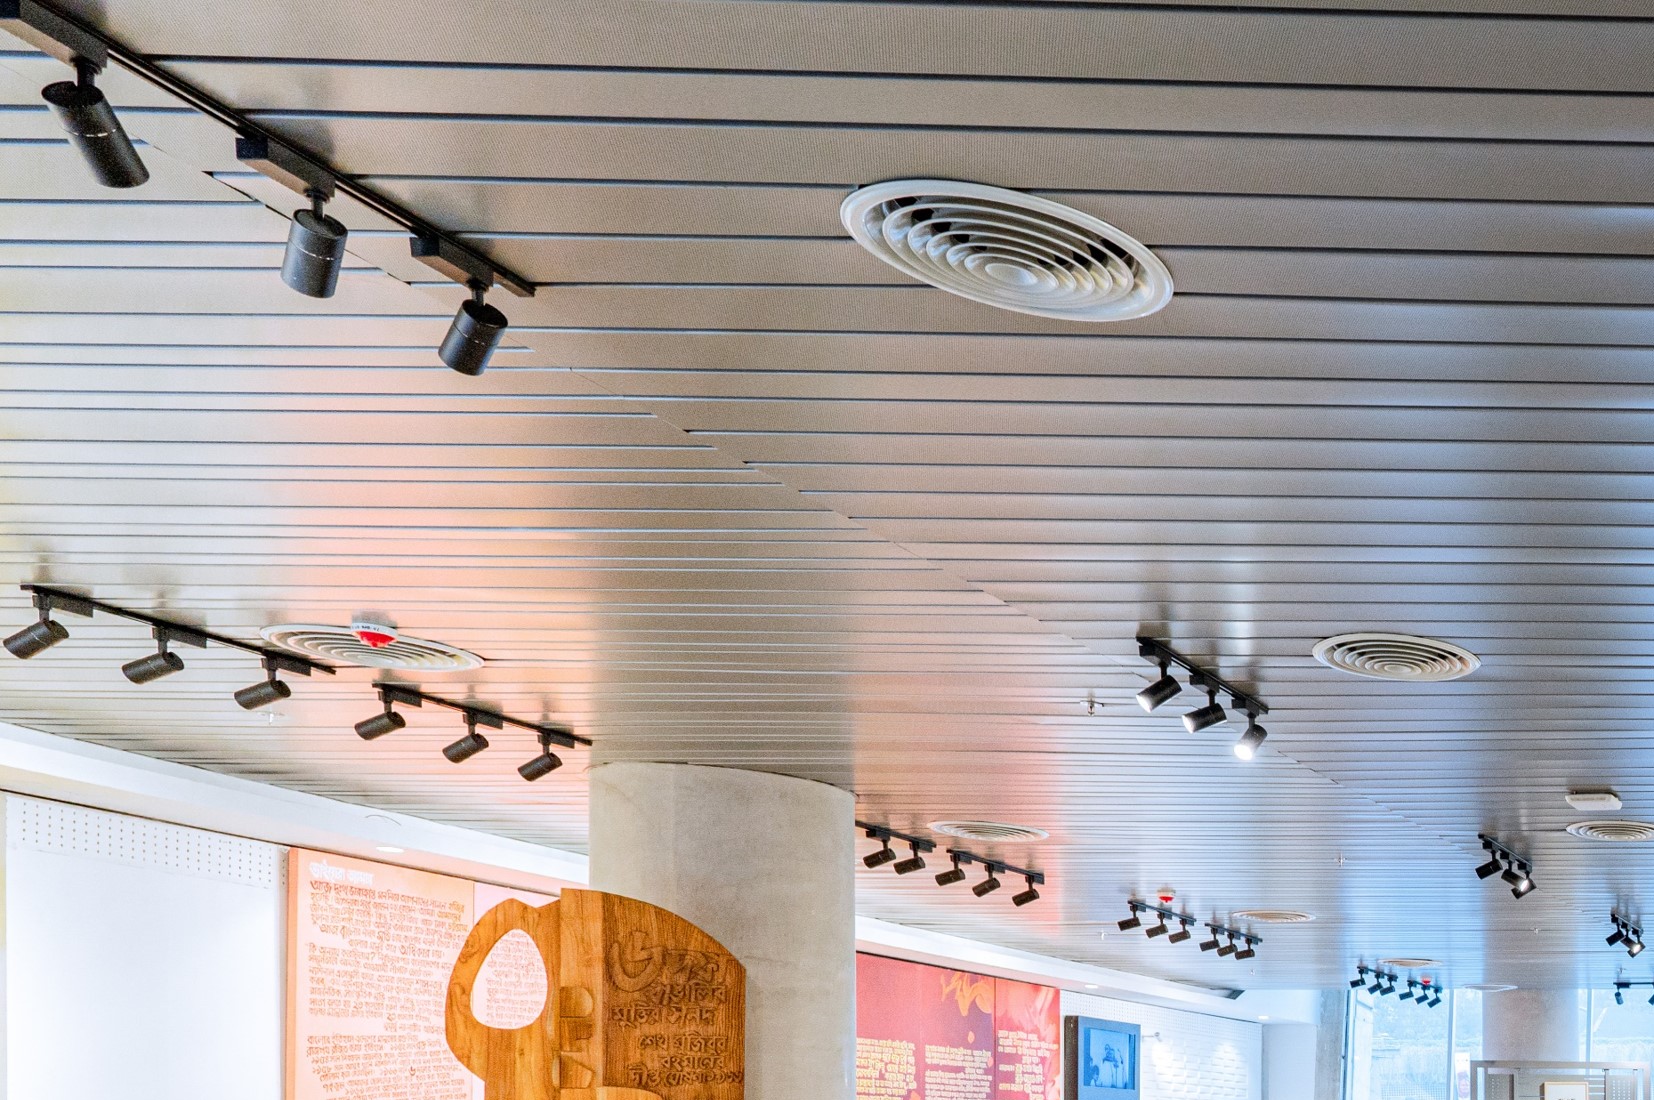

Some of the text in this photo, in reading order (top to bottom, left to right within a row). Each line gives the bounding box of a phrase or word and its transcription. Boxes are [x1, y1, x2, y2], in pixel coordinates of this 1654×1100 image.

[310, 880, 333, 894] আজ
[638, 1031, 728, 1055] শেখ মুজিবুর
